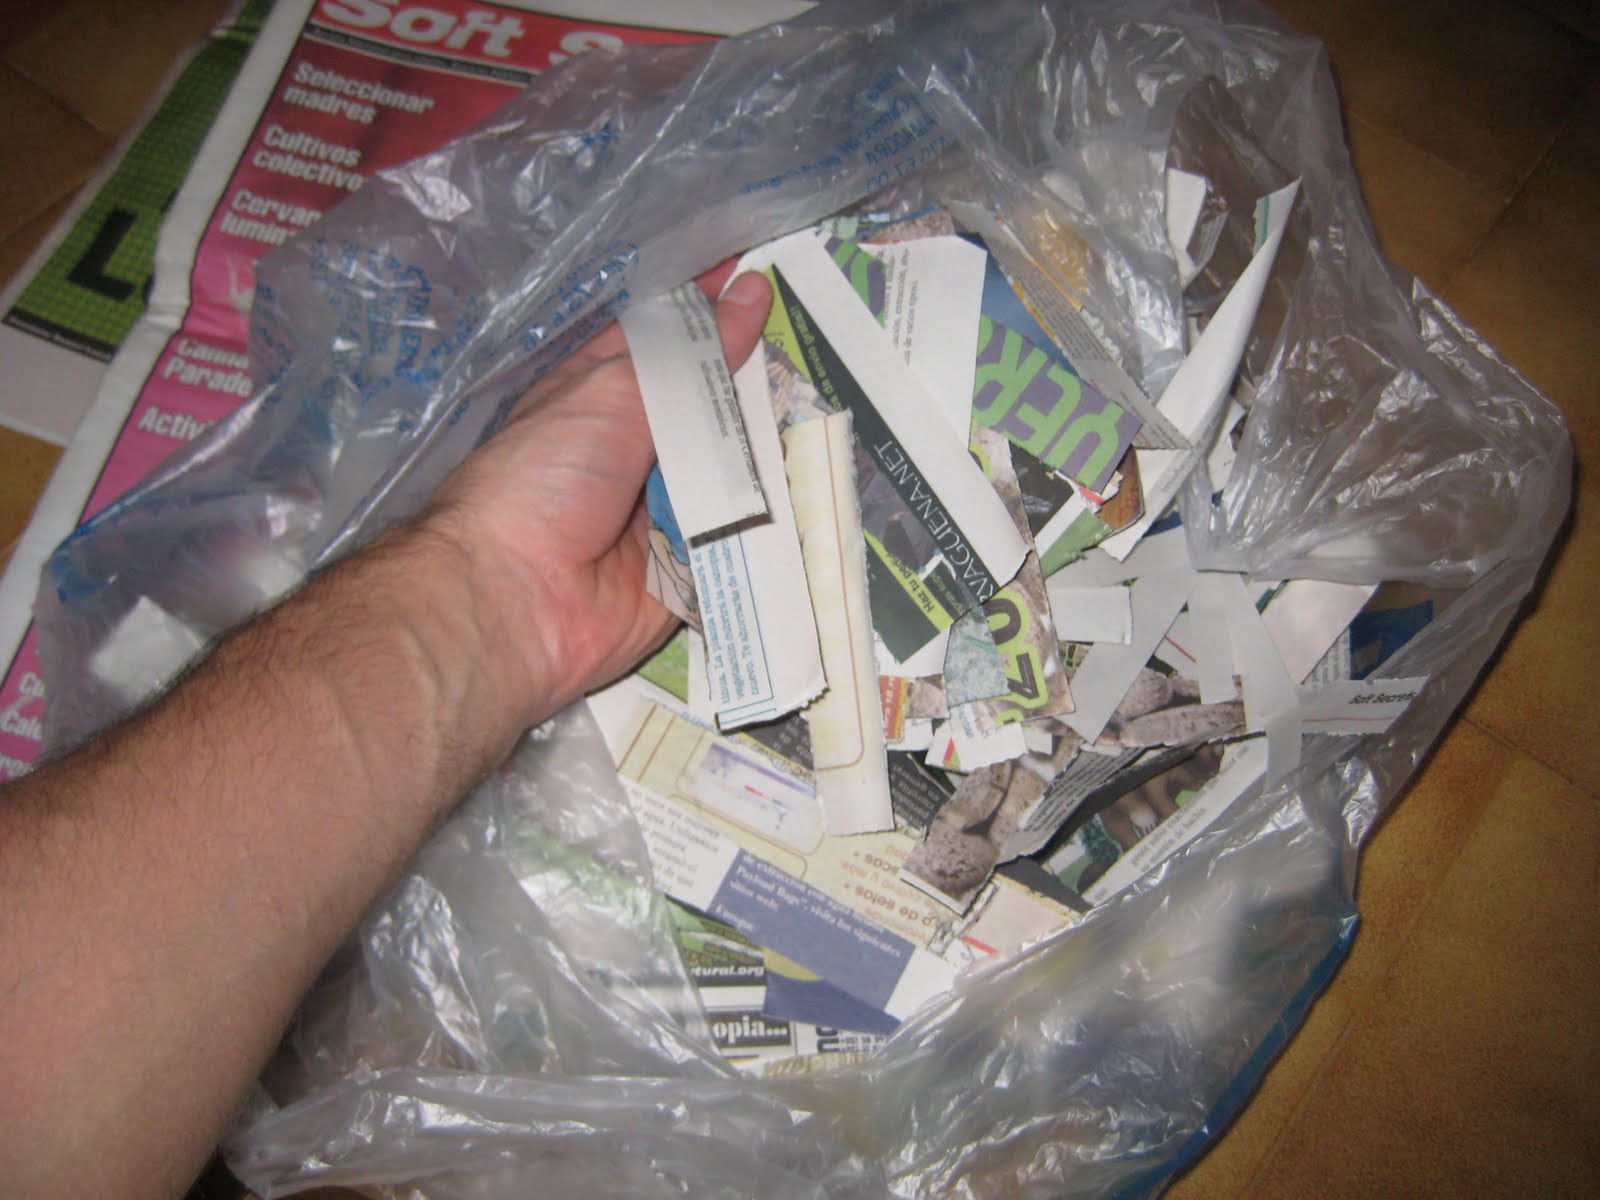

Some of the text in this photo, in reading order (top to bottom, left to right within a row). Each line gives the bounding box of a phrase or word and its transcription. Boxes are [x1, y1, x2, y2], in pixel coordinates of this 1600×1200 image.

[322, 0, 526, 57] Soft
[283, 86, 377, 124] madres
[295, 62, 436, 114] Seleccionar
[263, 124, 362, 167] Cultivos
[219, 211, 297, 246] lumin
[162, 357, 253, 397] Parade
[137, 405, 214, 441] Activ
[907, 578, 920, 592] tu
[914, 590, 935, 612] Haz
[741, 643, 751, 657] Te
[1348, 693, 1373, 703] Soft
[855, 885, 896, 910] setas
[899, 905, 919, 921] de
